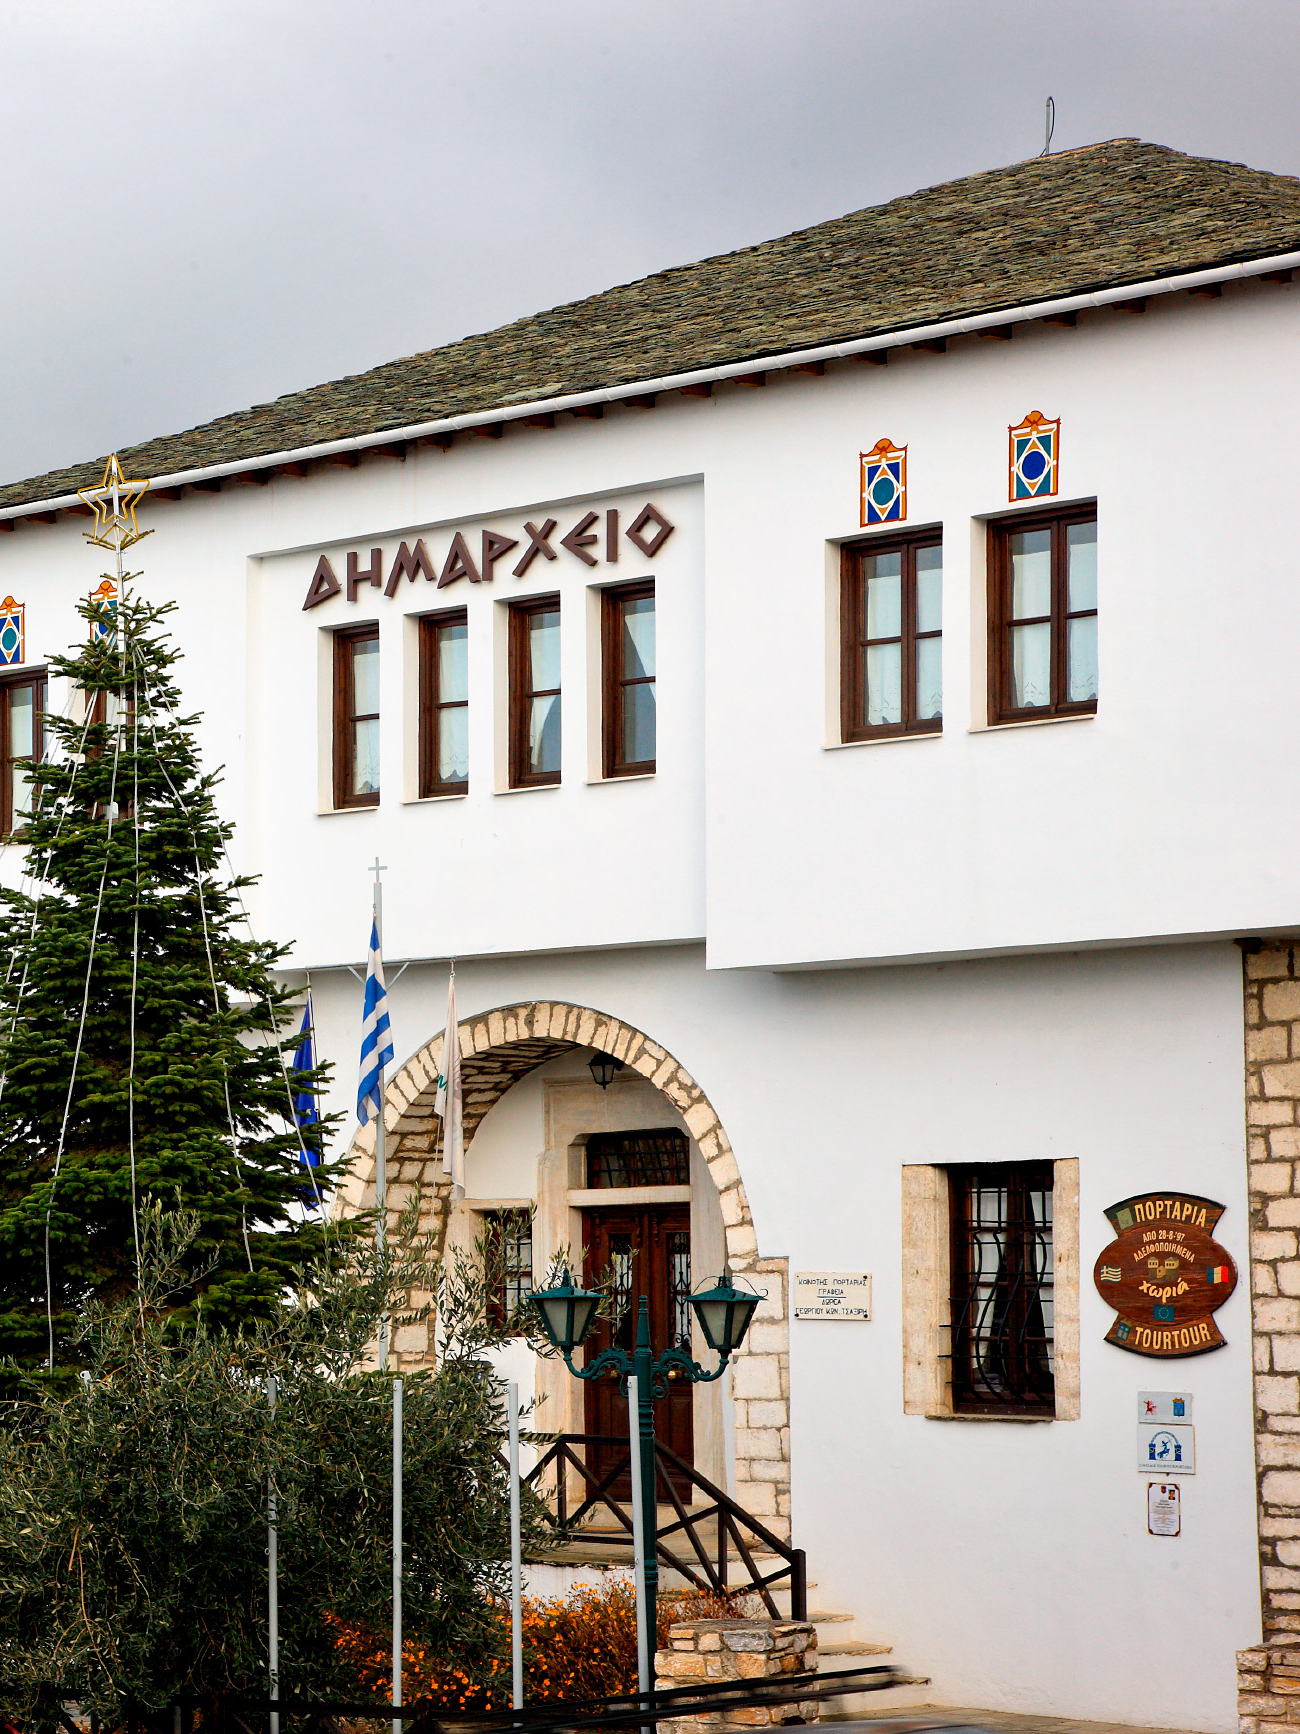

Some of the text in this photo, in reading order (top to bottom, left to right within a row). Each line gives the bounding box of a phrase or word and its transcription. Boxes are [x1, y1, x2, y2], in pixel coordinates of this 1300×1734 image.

[302, 503, 675, 611] ΔΗΜΑΡΧΕΙΟ
[1134, 1200, 1207, 1228] ΠΟΡΤΑΡΙΑ
[1142, 1231, 1157, 1243] ΑΠΟ
[1133, 1242, 1195, 1263] ΑΔΕΛΦΟΠΟΙΗΜΕΝΑ
[1138, 1277, 1190, 1304] χωριά
[1135, 1323, 1211, 1349] TOURTOUR
